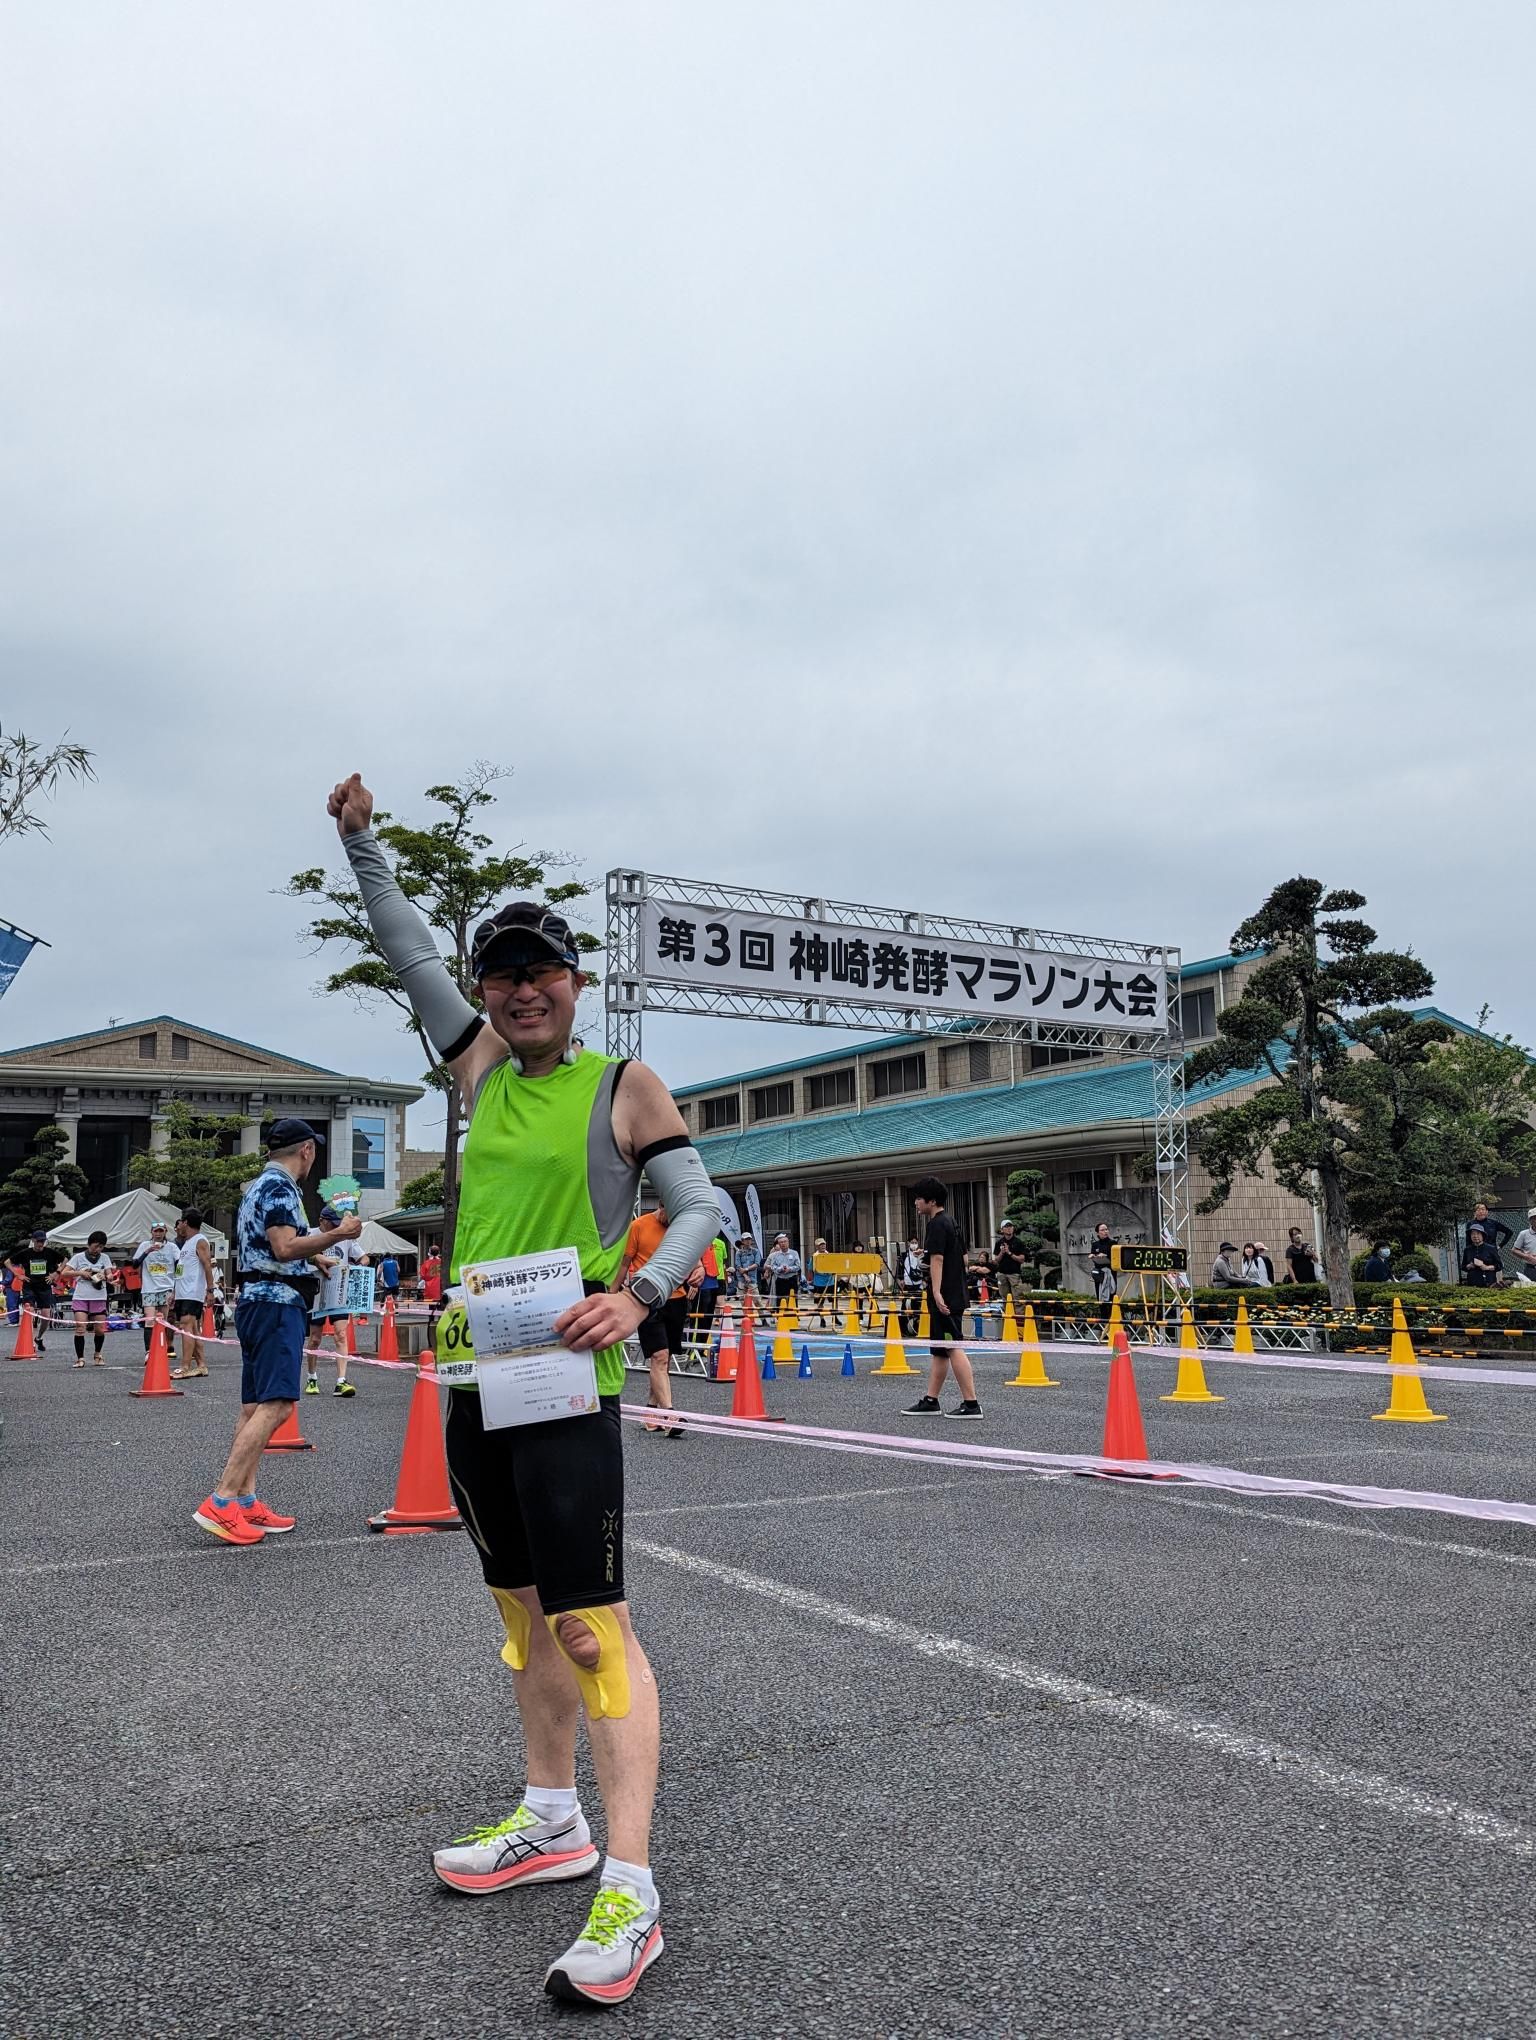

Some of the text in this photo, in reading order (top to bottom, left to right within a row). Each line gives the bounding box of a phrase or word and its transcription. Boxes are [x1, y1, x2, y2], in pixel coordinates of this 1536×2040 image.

[657, 916, 1158, 1018] 第3回 神崎発酵マラソン大会
[481, 1266, 573, 1291] 神崎発酵マラソン
[536, 1261, 572, 1271] MARATHON
[605, 1543, 614, 1583] 2XU
